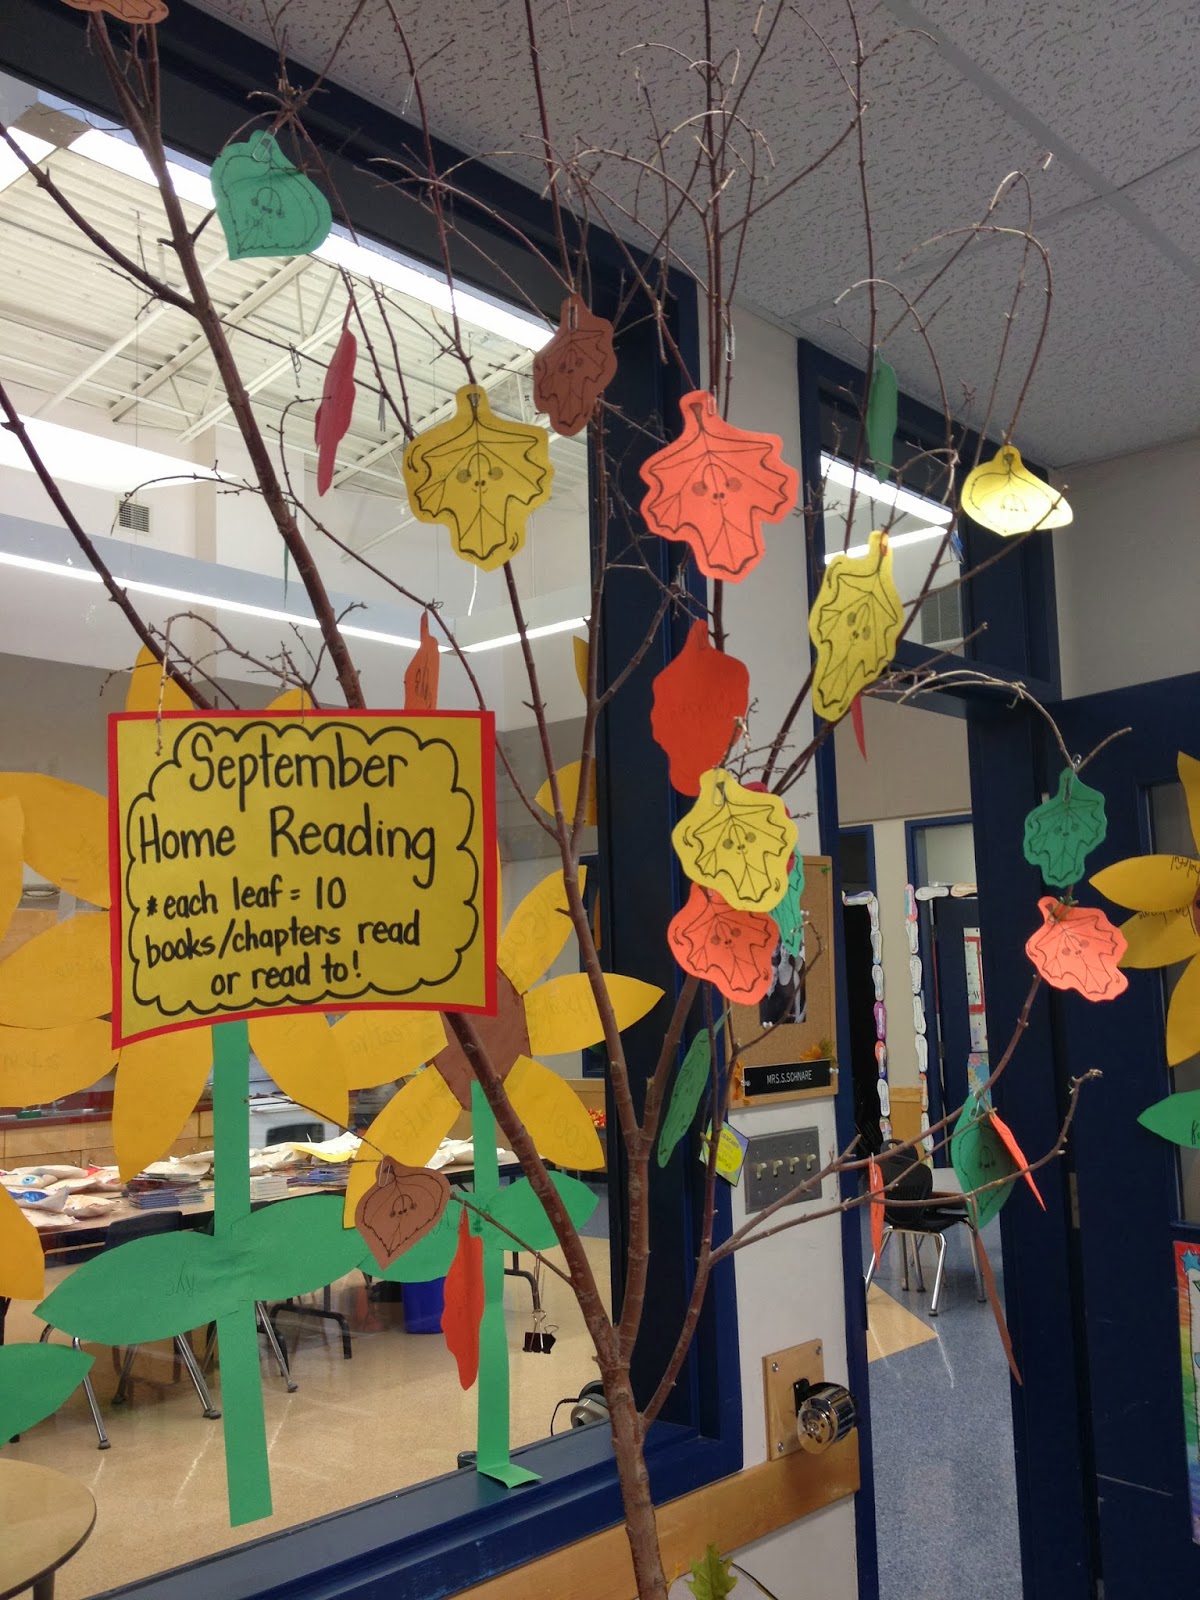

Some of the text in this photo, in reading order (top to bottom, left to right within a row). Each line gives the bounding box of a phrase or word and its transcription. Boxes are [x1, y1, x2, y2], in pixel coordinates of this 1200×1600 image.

[190, 732, 408, 812] September
[140, 813, 236, 864] Home
[270, 803, 435, 889] Reading
[232, 874, 282, 910] leaf
[316, 877, 346, 910] 10
[145, 909, 420, 968] books/chapters read
[211, 950, 361, 995] or read to!
